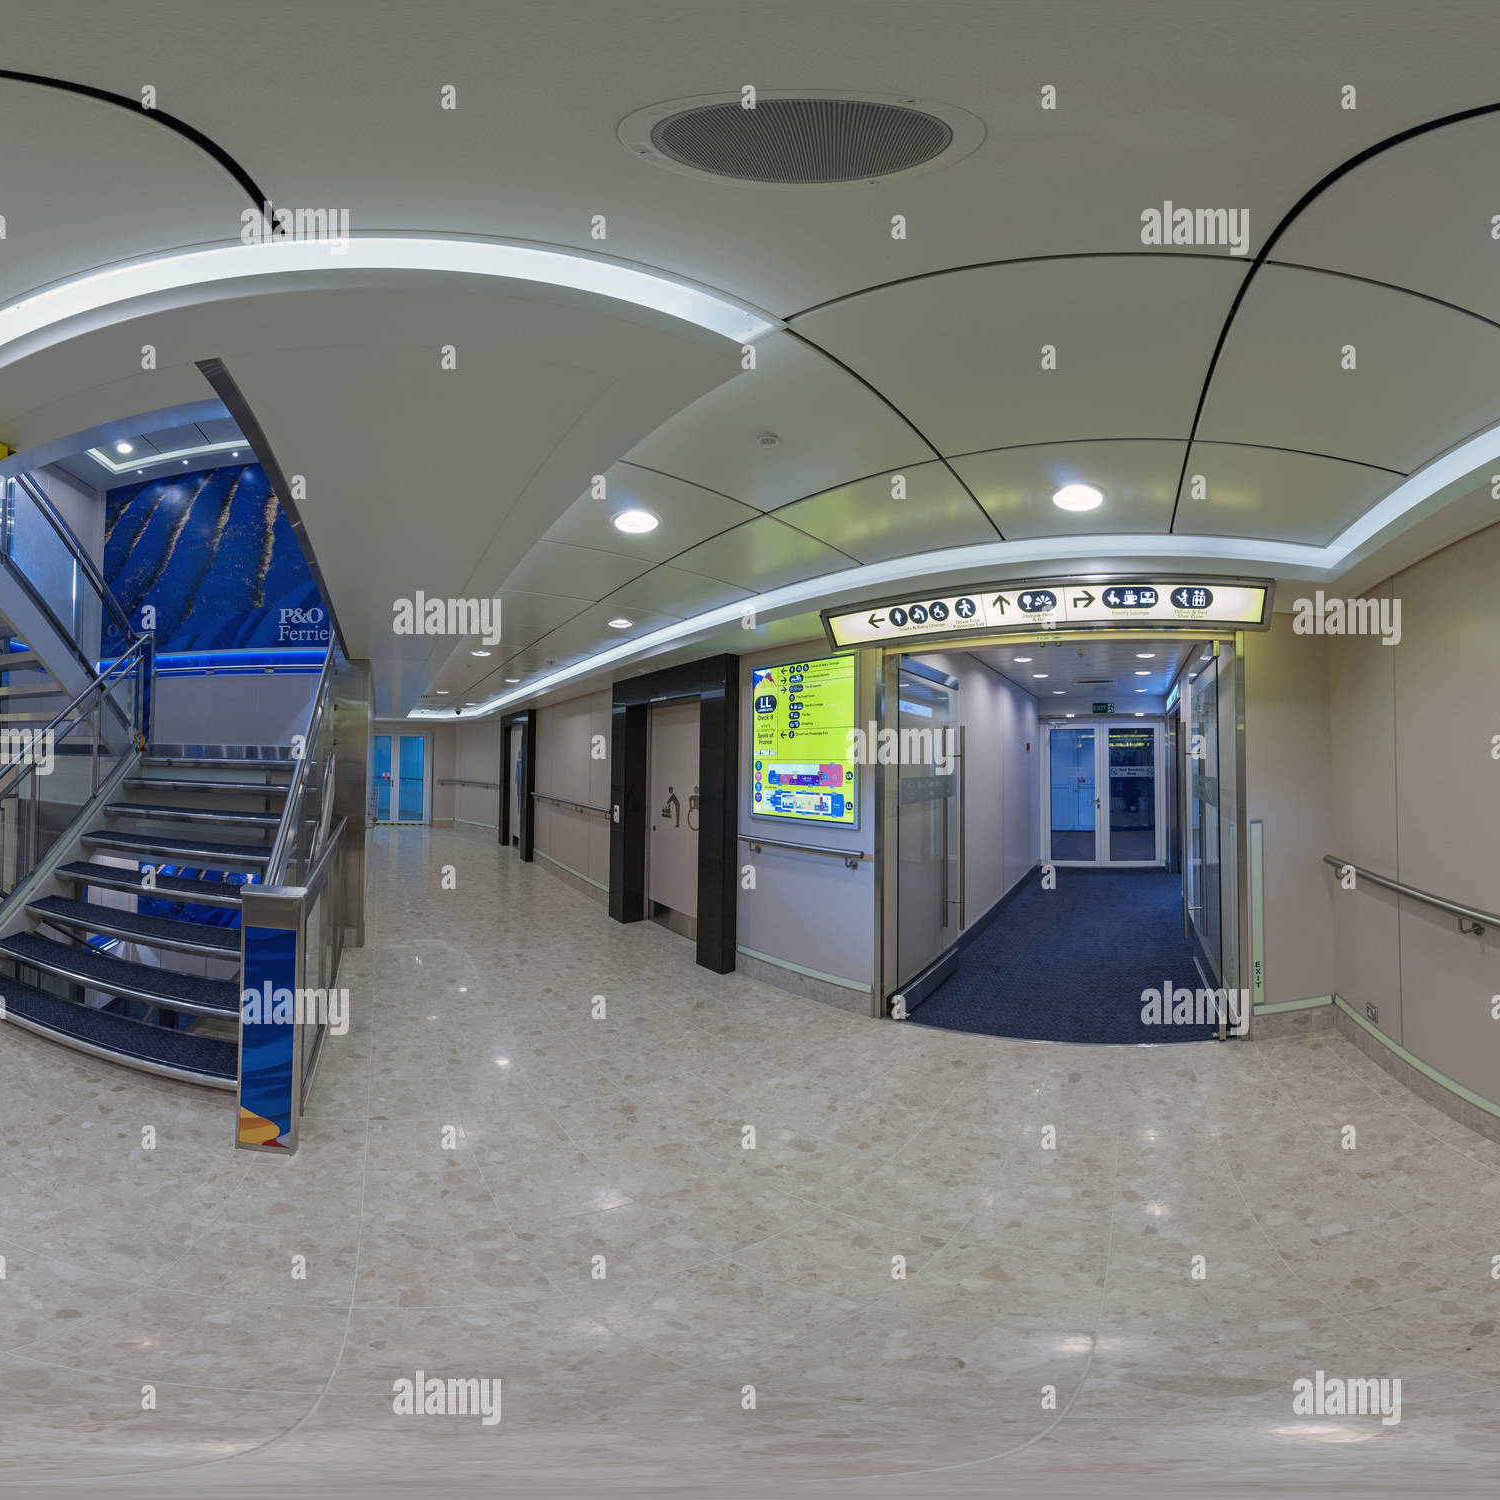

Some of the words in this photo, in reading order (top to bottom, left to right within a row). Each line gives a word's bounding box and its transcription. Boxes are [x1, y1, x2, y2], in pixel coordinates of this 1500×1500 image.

[278, 607, 324, 624] P&O
[278, 625, 329, 641] Ferrie
[760, 696, 772, 708] LL
